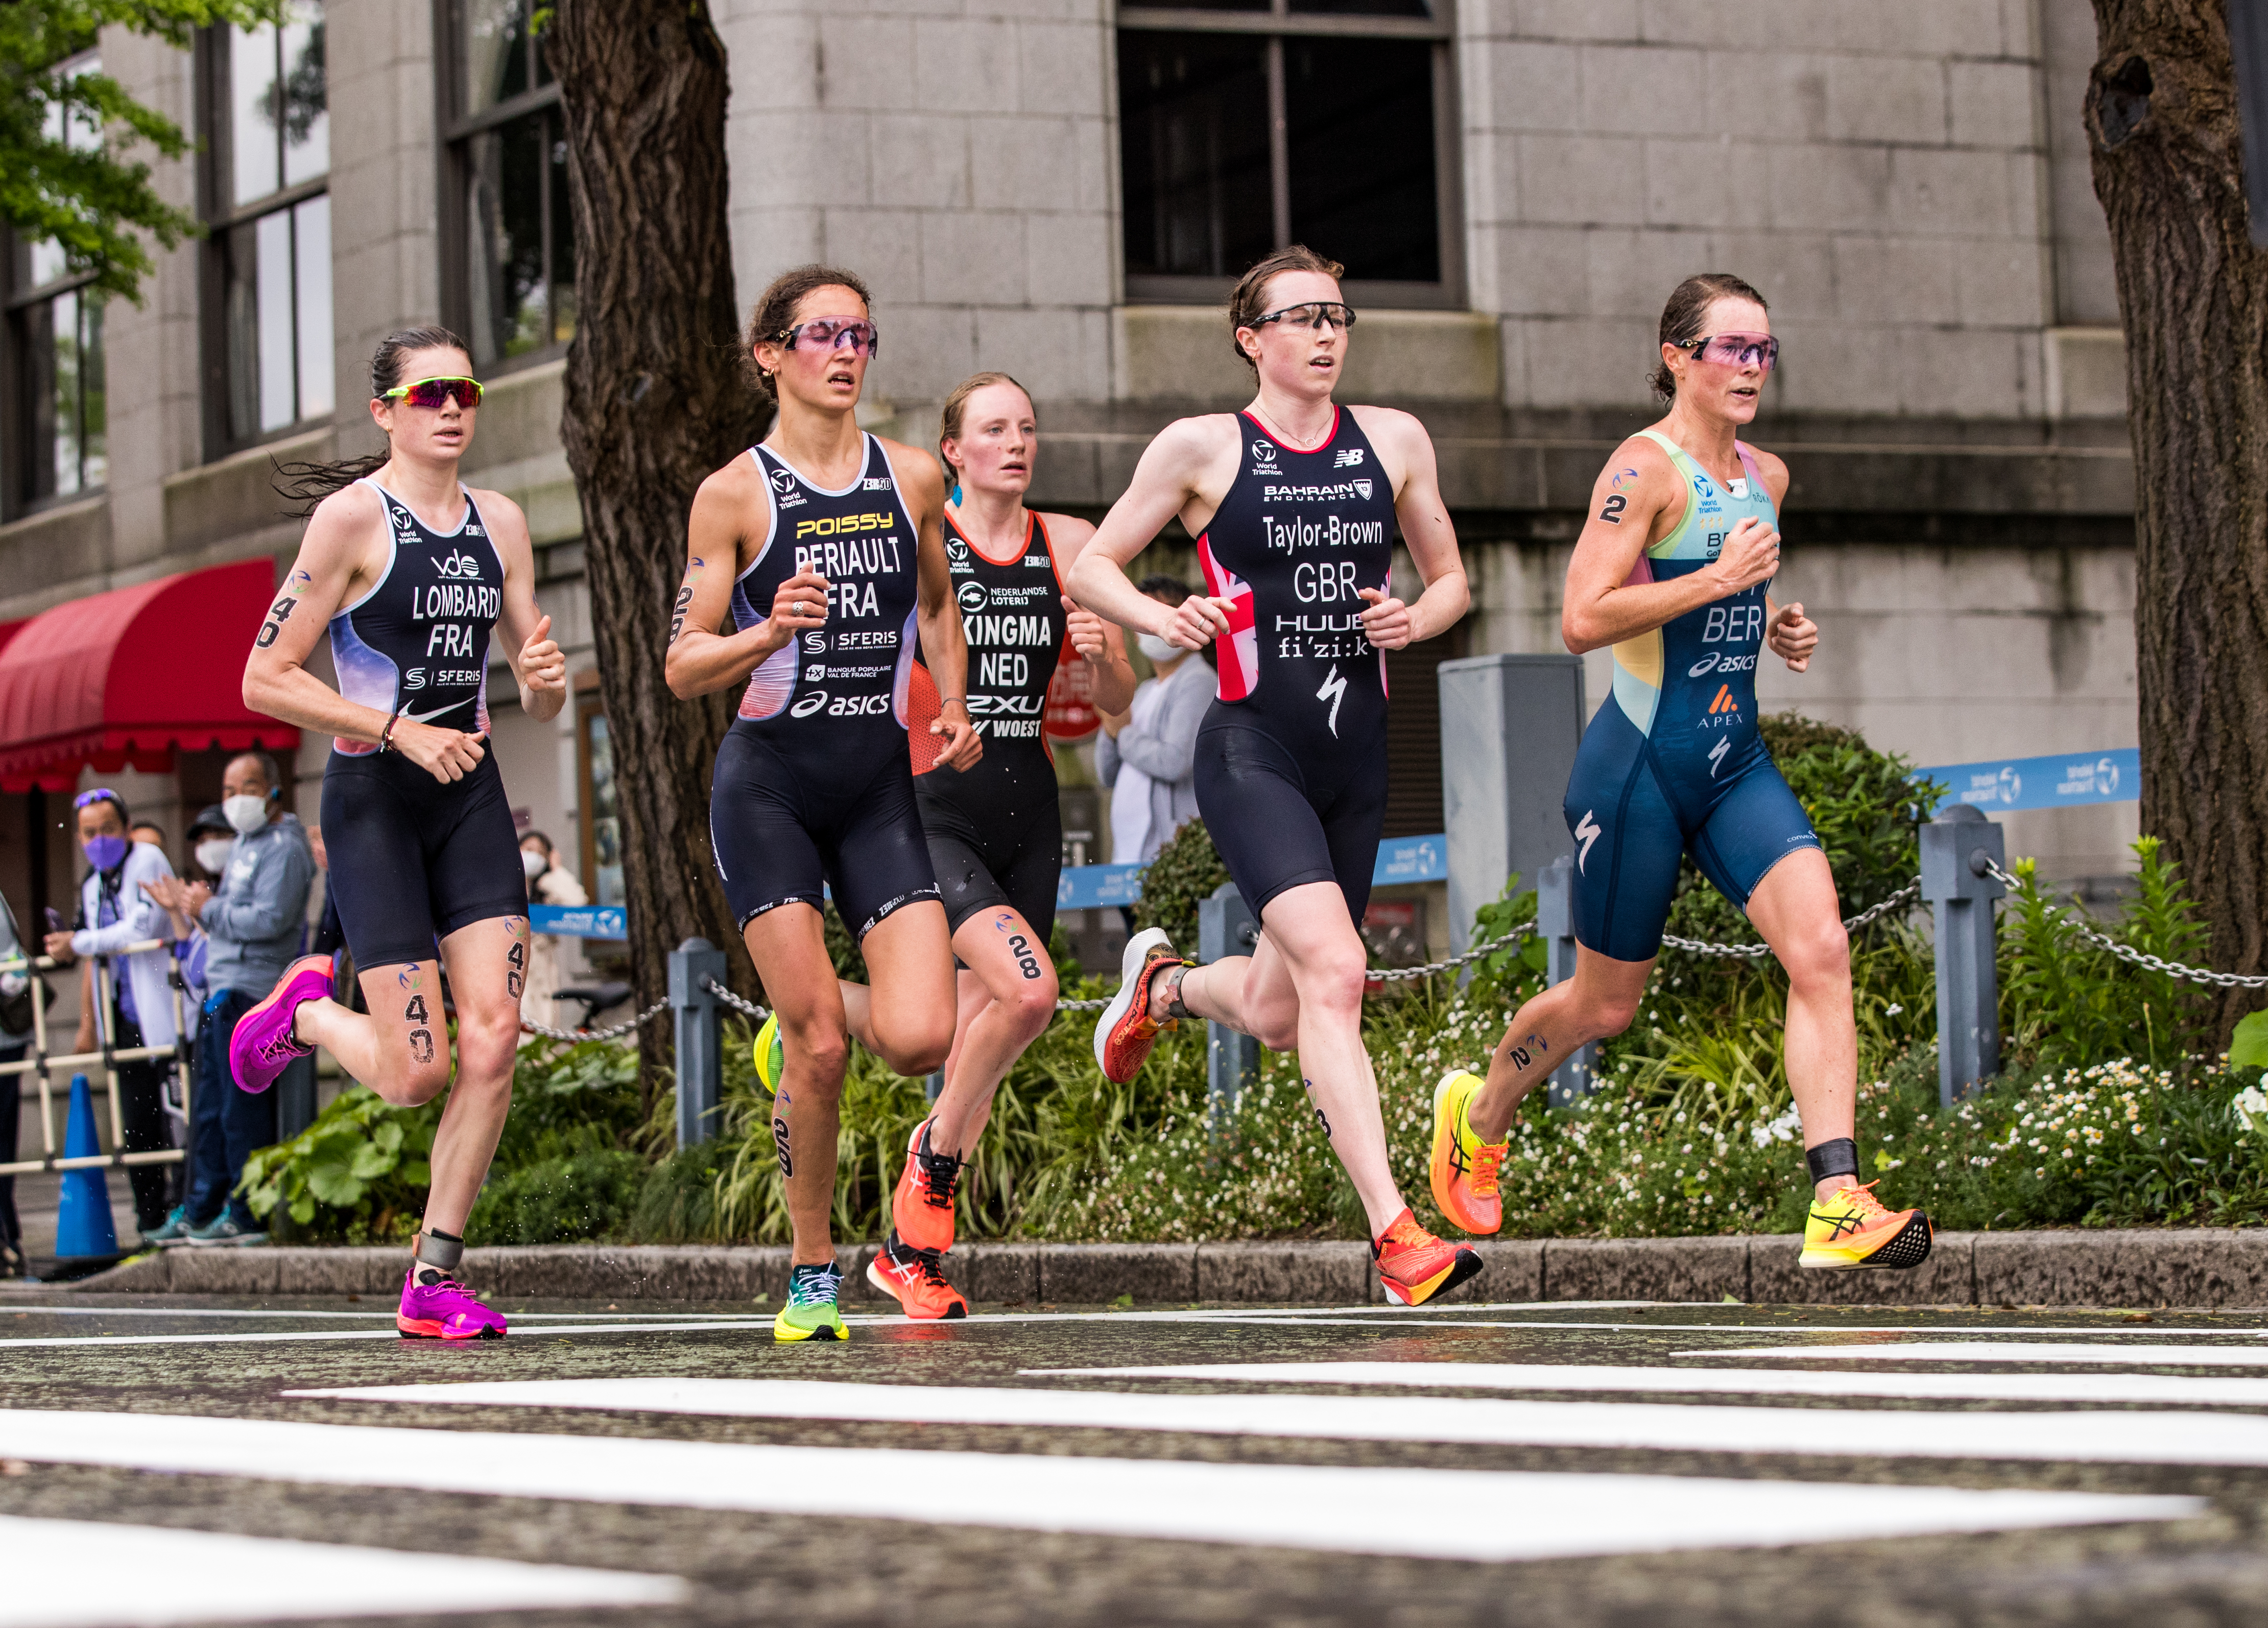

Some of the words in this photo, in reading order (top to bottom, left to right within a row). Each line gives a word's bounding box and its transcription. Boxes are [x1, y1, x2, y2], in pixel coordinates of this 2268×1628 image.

[779, 498, 807, 510] Triathlon
[780, 492, 800, 502] World
[1264, 483, 1353, 495] BAHRAIN
[1264, 493, 1355, 502] ENDURANCE
[1597, 494, 1628, 525] 2
[797, 512, 893, 538] POISSY
[1263, 515, 1382, 555] Taylor-Brown
[795, 537, 900, 578] PERIAULT
[991, 587, 1048, 596] NEDERLANDSE
[1295, 561, 1361, 602] GBR
[413, 585, 500, 620] LOMBARDI
[823, 582, 879, 619] FRA
[991, 597, 1029, 605] LOTERIJ
[255, 596, 299, 649] 40
[961, 616, 1051, 646] KINGMA
[1702, 605, 1761, 642] BER
[427, 624, 472, 657] FRA
[980, 653, 1028, 686] NED
[966, 695, 1044, 714] 2XU
[993, 720, 1041, 737] WOEST
[1697, 713, 1743, 729] APEX
[1787, 834, 1813, 842] convex
[506, 941, 524, 999] 40
[1007, 934, 1042, 980] 28
[404, 994, 435, 1064] 40
[1509, 1046, 1532, 1072] 2
